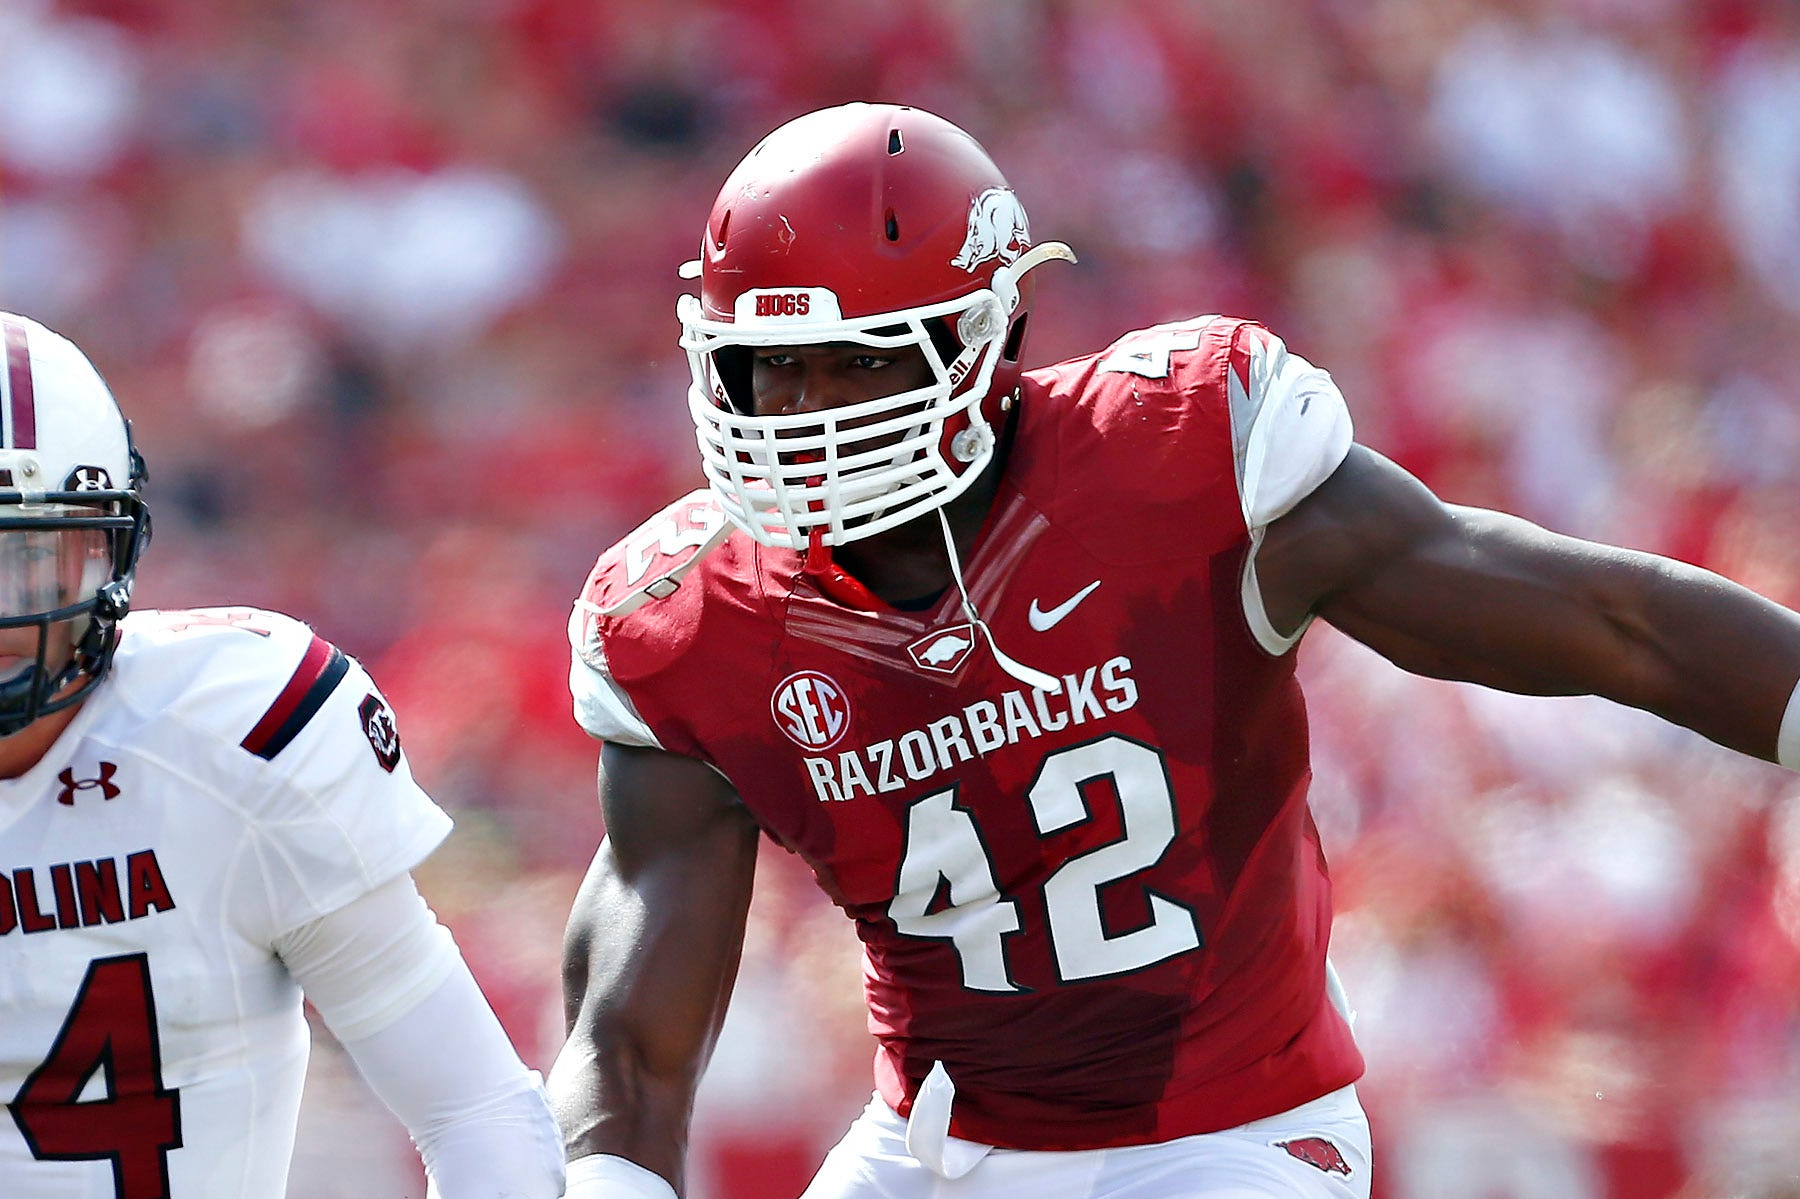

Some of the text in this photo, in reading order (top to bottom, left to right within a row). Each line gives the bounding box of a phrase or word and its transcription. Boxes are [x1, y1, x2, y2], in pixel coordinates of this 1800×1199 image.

[755, 293, 810, 316] HOGS
[776, 677, 844, 745] SEC
[803, 656, 1139, 801] RAZORBACKS
[887, 731, 1204, 995] 42
